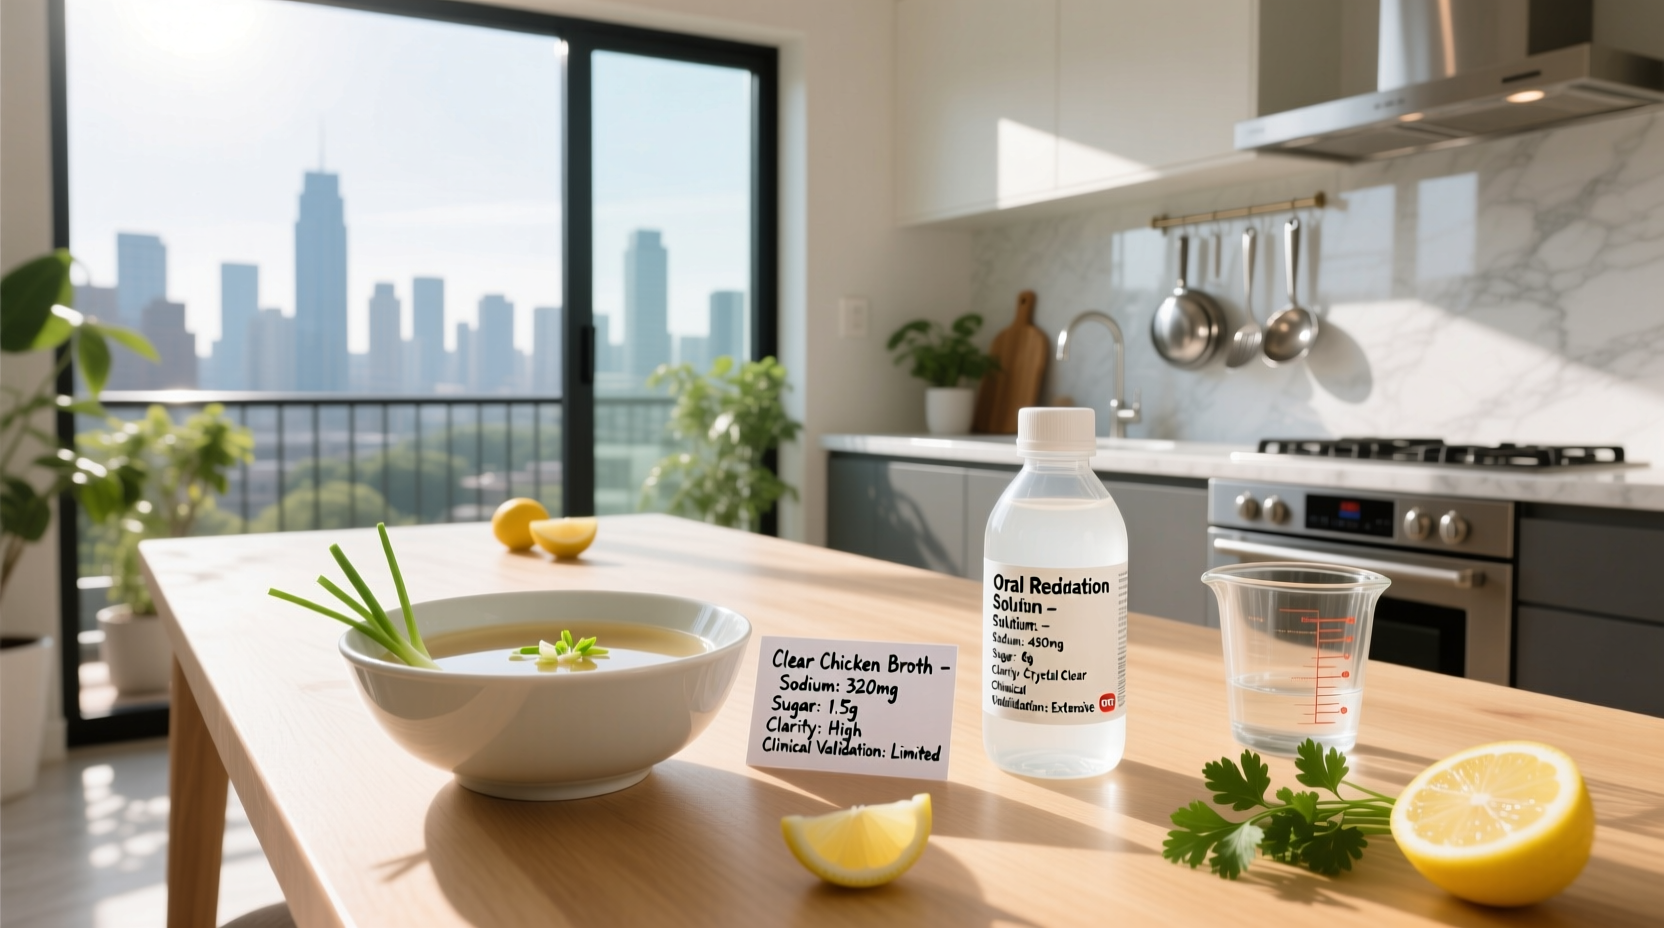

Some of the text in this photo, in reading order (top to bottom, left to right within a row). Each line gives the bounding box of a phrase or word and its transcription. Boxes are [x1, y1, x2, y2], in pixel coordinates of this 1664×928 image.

[993, 573, 1024, 593] Oral
[772, 648, 815, 669] Clear
[820, 651, 881, 672] Chicken
[888, 654, 933, 675] Broth
[1060, 669, 1087, 681] Clear
[779, 674, 899, 704] Sodium: 320mg
[771, 695, 858, 722] Sugar: 1.5g
[766, 716, 862, 743] Clarity: High
[762, 736, 942, 762] Clinical Validation: Limited
